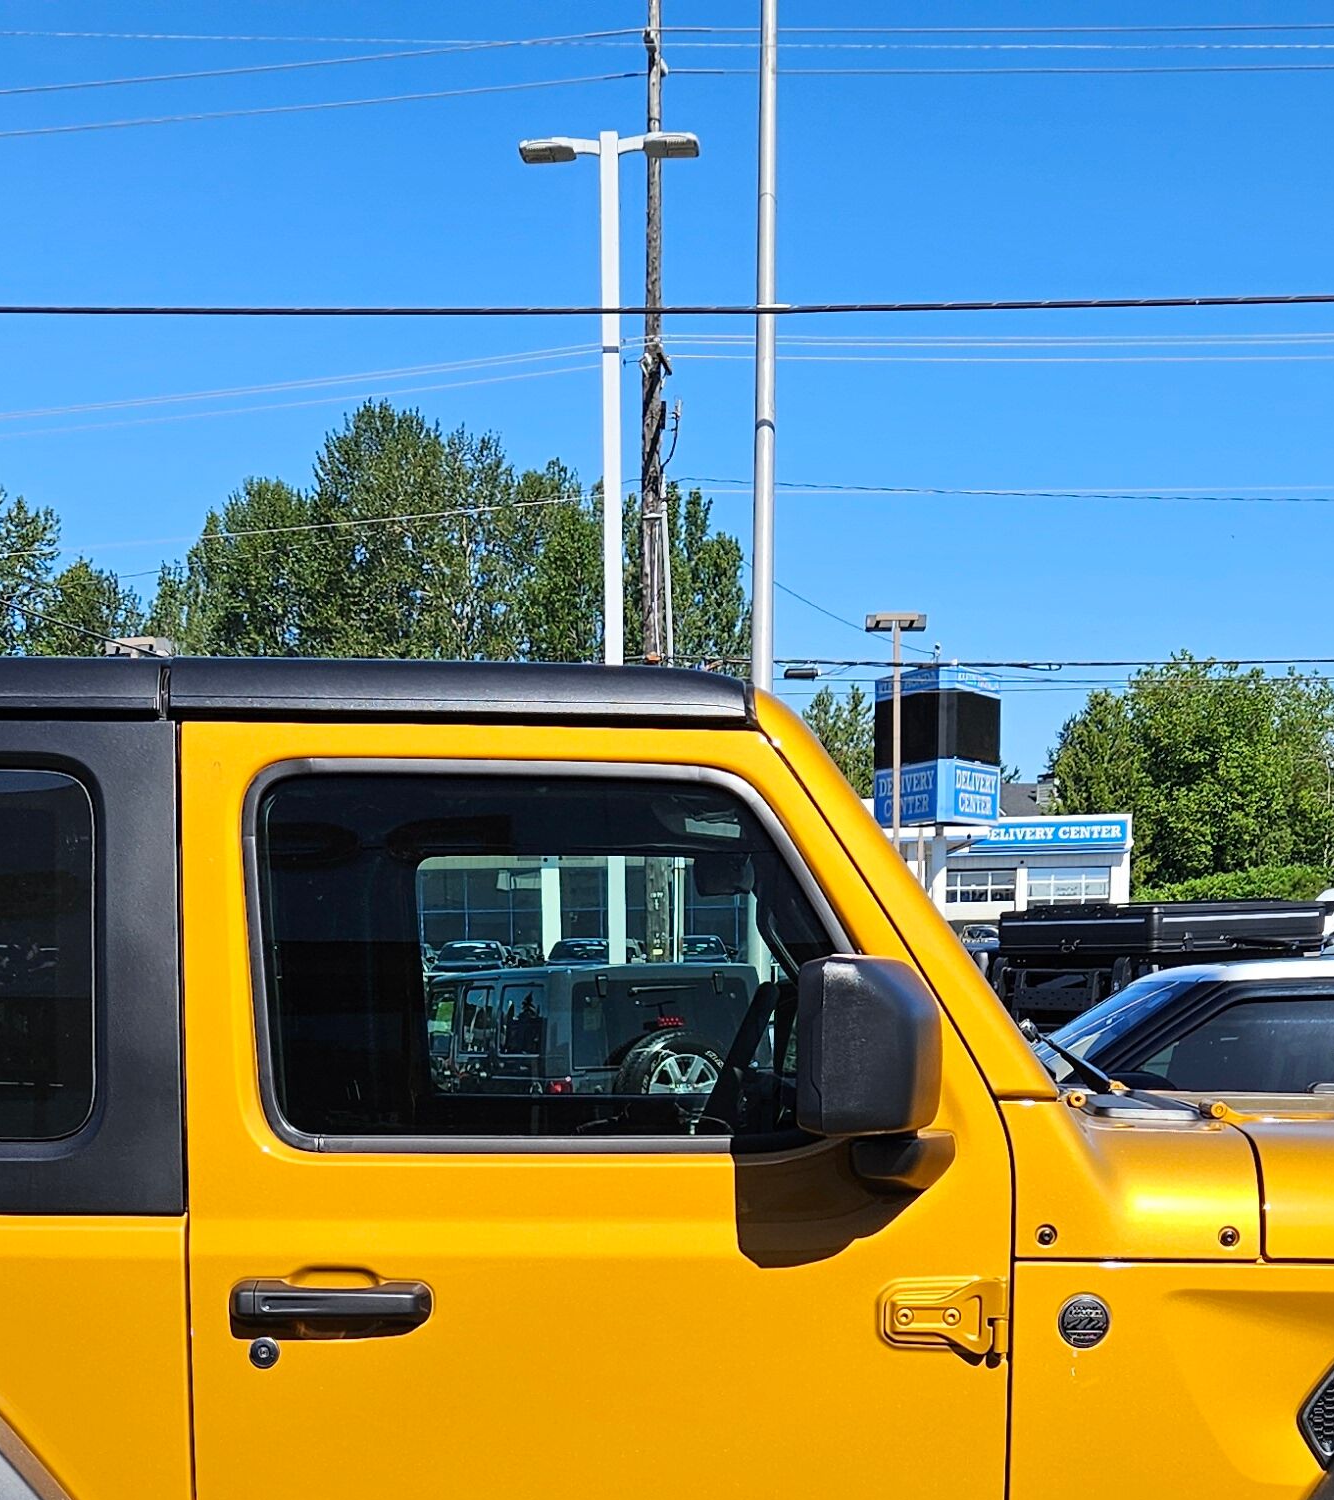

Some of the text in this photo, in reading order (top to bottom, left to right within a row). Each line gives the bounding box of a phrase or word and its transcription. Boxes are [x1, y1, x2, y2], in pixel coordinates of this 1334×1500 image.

[878, 769, 935, 797] DEIVERY
[956, 769, 996, 794] DELIVERY
[884, 793, 929, 817] CNTER
[958, 792, 992, 815] CENTER
[1058, 825, 1122, 839] CENTER
